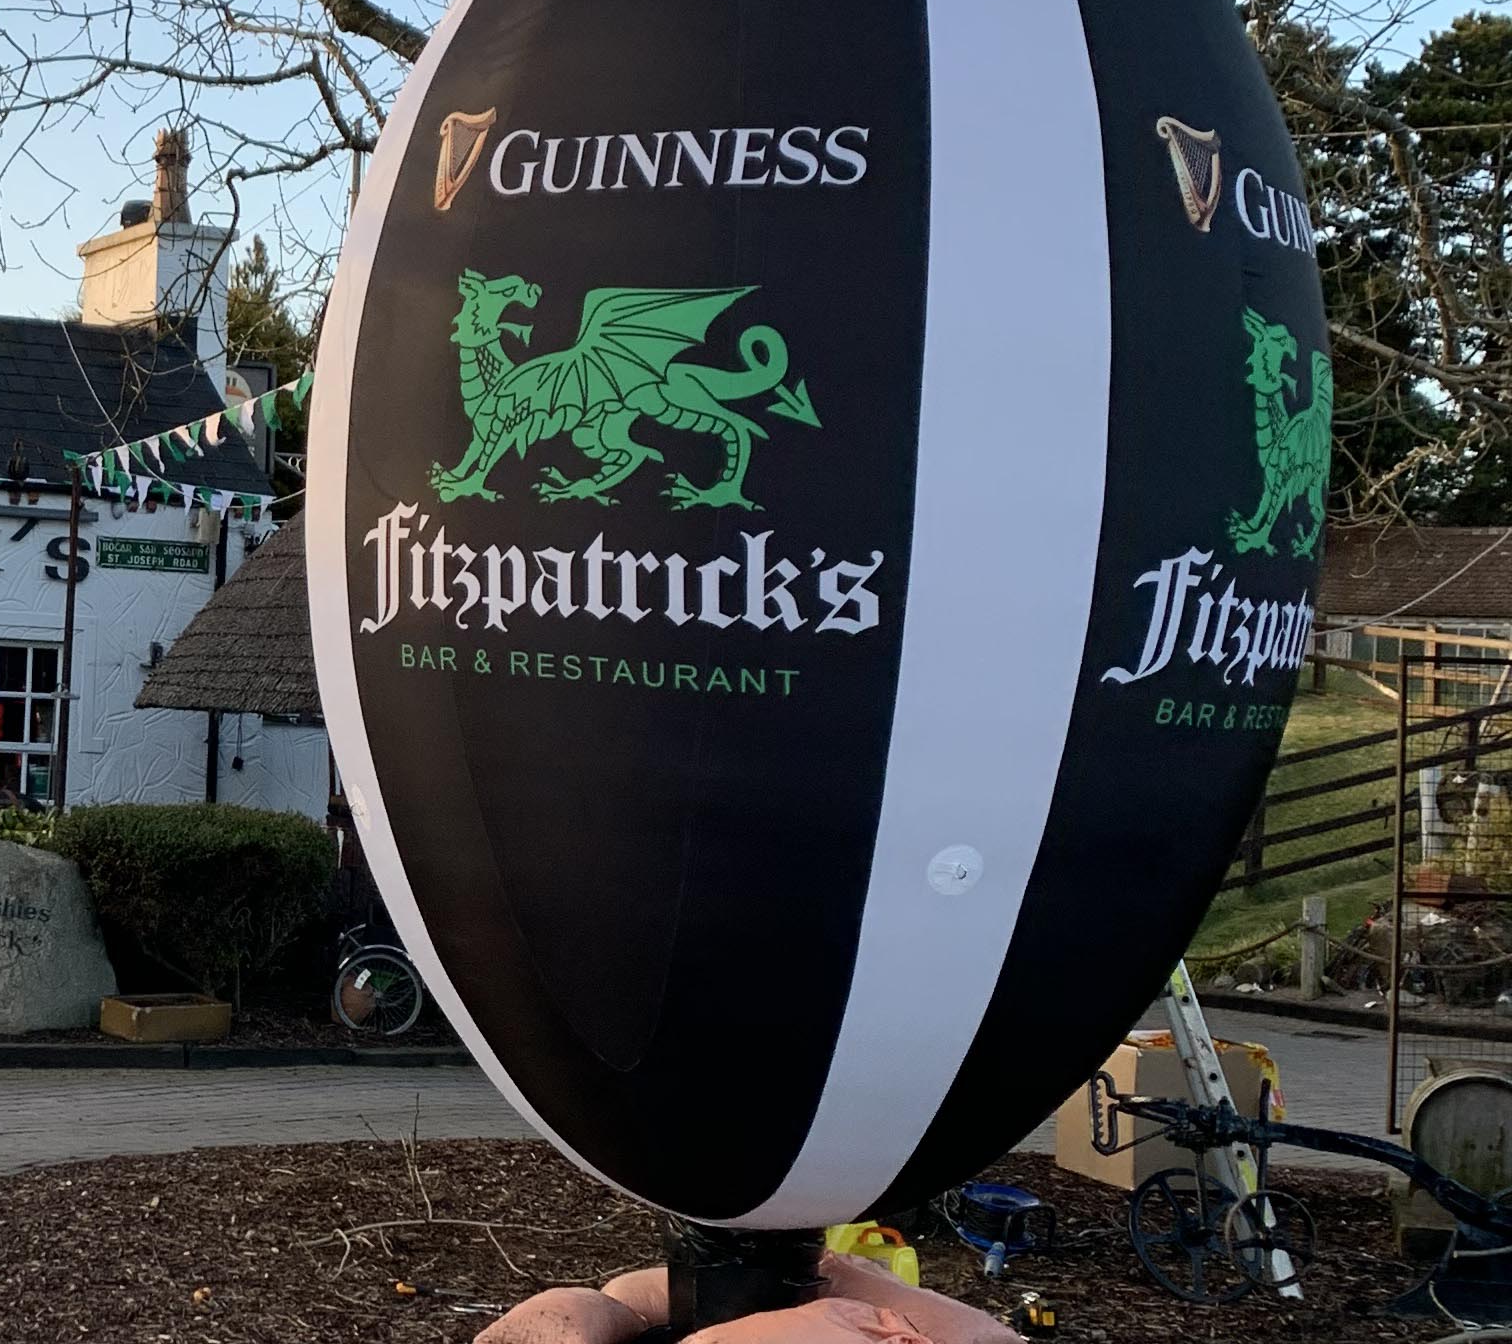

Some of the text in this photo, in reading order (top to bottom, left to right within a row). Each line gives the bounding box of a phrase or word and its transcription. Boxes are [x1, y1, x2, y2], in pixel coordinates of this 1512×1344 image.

[489, 125, 870, 196] GUINNESS
[107, 553, 199, 569] ST JOSEPH ROAD
[358, 501, 885, 636] Fitzpatrick's
[399, 643, 801, 697] BAR & RESTAURANT
[1155, 698, 1216, 729] BAR
[1223, 705, 1236, 729] &
